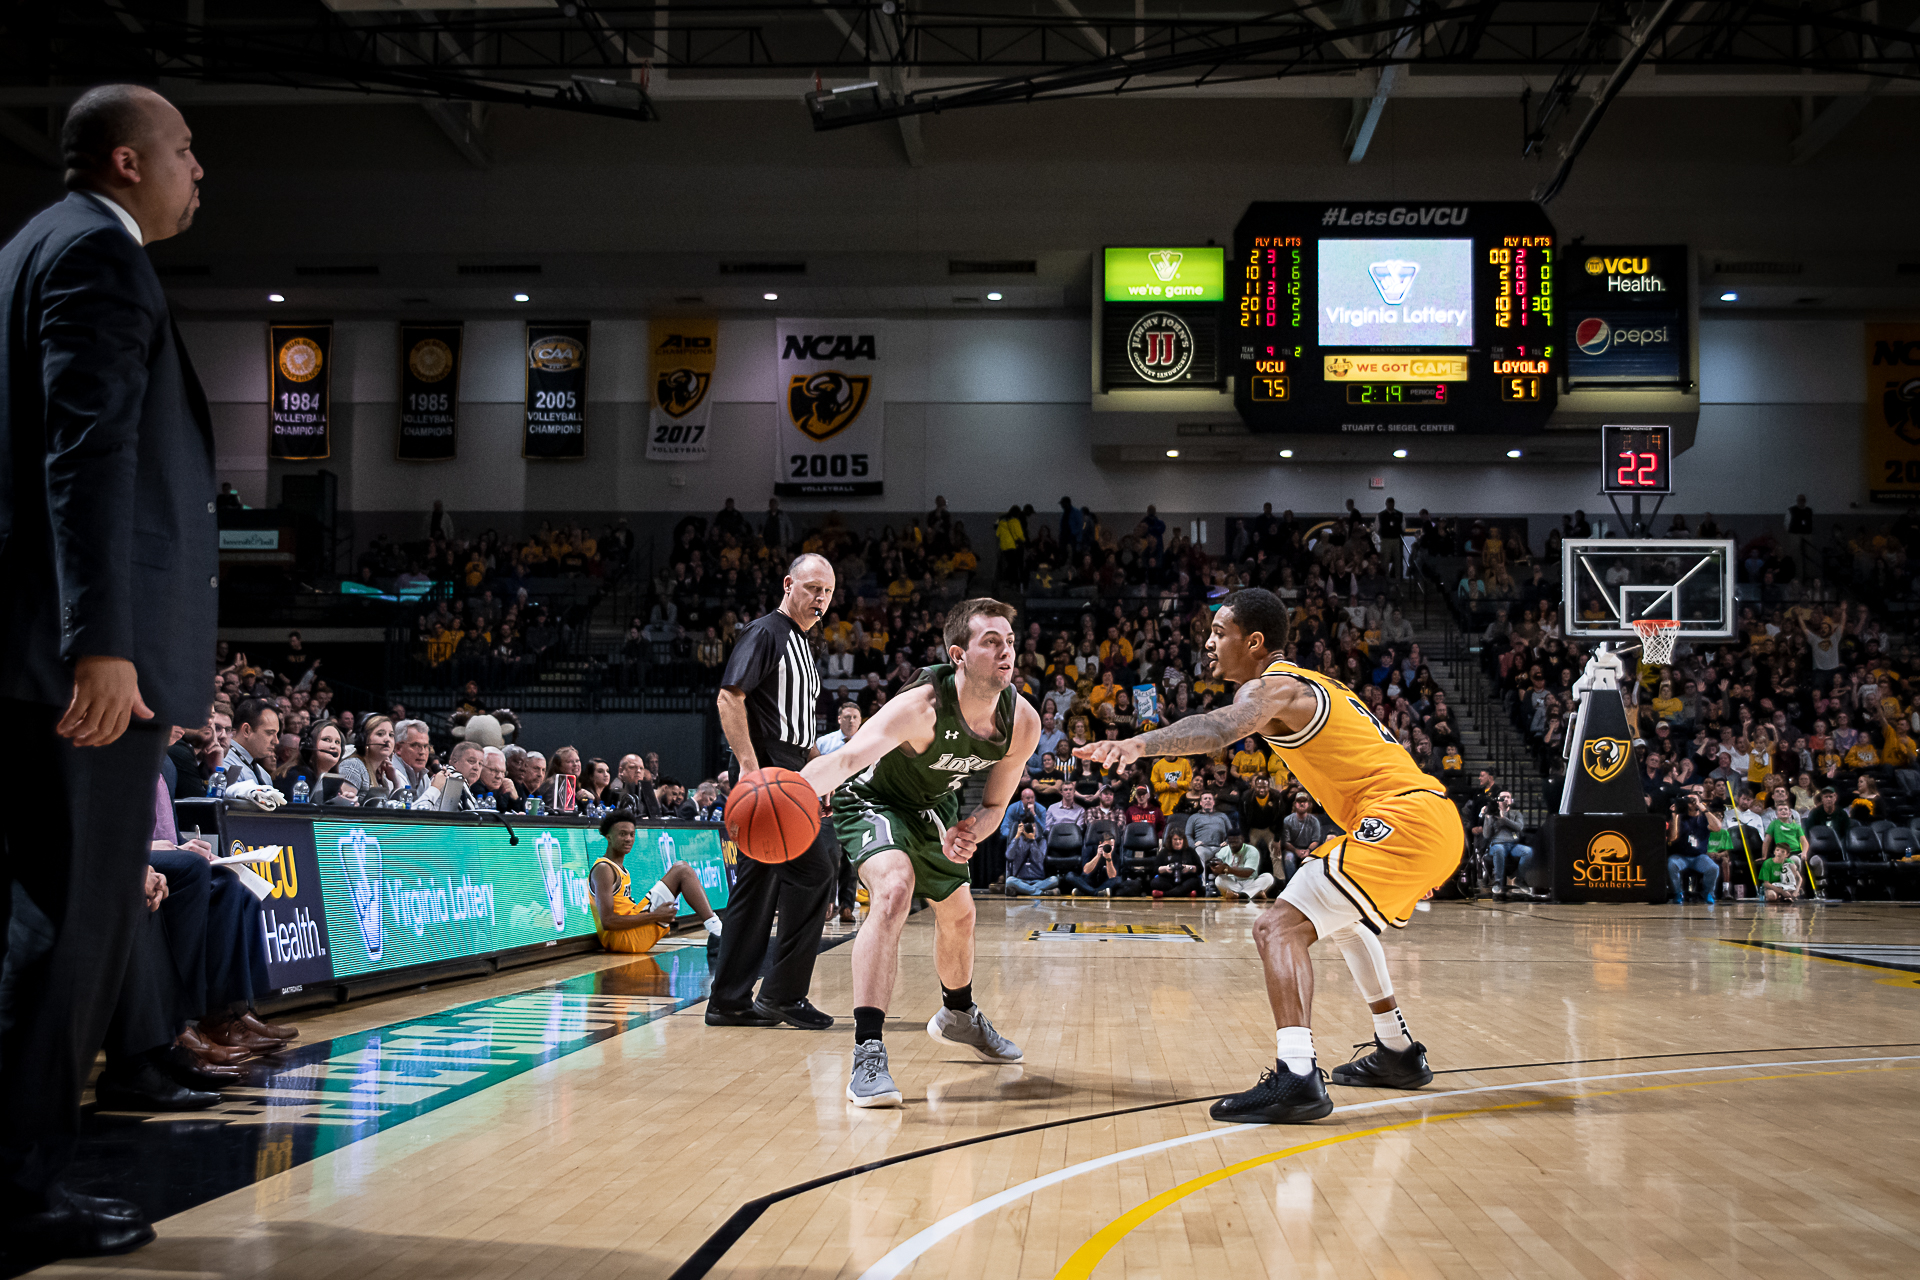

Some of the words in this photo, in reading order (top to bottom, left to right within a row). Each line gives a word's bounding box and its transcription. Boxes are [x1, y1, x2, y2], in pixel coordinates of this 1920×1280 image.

[1321, 207, 1468, 227] #LetsGoVCU
[1255, 237, 1270, 247] PLY
[1273, 237, 1284, 247] FL
[1285, 237, 1301, 247] PTS
[1503, 237, 1519, 247] PLY
[1522, 237, 1533, 247] FL
[1534, 237, 1551, 247] PTS
[1250, 249, 1259, 264] 2
[1267, 249, 1276, 264] 3
[1291, 249, 1300, 264] 5
[1489, 248, 1511, 264] 00
[1515, 248, 1526, 264] 2
[1541, 248, 1553, 264] 7
[1246, 265, 1259, 279] 10
[1271, 265, 1276, 279] 1
[1291, 265, 1300, 279] 6
[1499, 265, 1511, 280] 2
[1515, 265, 1526, 280] 0
[1541, 265, 1552, 280] 0
[1604, 258, 1650, 274] VCU
[1127, 284, 1161, 297] we're
[1164, 284, 1203, 298] game
[1246, 281, 1259, 295] 11
[1267, 281, 1276, 295] 3
[1287, 281, 1300, 295] 12
[1500, 281, 1511, 295] 3
[1515, 281, 1526, 295] 0
[1541, 281, 1552, 295] 0
[1608, 276, 1662, 292] Health
[1240, 296, 1259, 311] 20
[1266, 296, 1276, 311] 0
[1291, 296, 1300, 311] 2
[1495, 296, 1511, 311] 10
[1521, 296, 1527, 311] 1
[1532, 296, 1553, 311] 30
[1240, 312, 1259, 327] 21
[1266, 312, 1276, 327] 0
[1291, 312, 1300, 327] 2
[1325, 305, 1398, 327] Virginia
[1402, 305, 1466, 327] Lottery
[1495, 312, 1511, 327] 12
[1521, 312, 1527, 327] 1
[1542, 312, 1553, 327] 7
[1132, 317, 1159, 349] JIMMY
[1161, 317, 1189, 349] JOHN'S
[1613, 325, 1667, 347] pepsi
[538, 347, 574, 360] CAA
[781, 335, 877, 360] NCAA
[1145, 331, 1175, 366] JJ
[1266, 345, 1275, 357] 9
[1294, 345, 1303, 358] 2
[1517, 345, 1526, 357] 7
[1543, 345, 1554, 358] 2
[1255, 361, 1285, 373] VCU
[1356, 363, 1378, 373] WE
[1381, 363, 1409, 373] GOT
[1411, 361, 1463, 375] GAME
[1493, 360, 1549, 374] LOYOLA
[1262, 379, 1285, 398] 75
[1361, 385, 1402, 403] 2:19
[1409, 388, 1436, 396] PERIOD
[1435, 384, 1445, 400] 2
[1511, 379, 1538, 398] 51
[280, 392, 321, 411] 1984
[408, 393, 449, 412] 1985
[535, 391, 577, 409] 2005
[273, 412, 327, 423] VOLLEYBALL
[527, 411, 583, 422] VOLLEYBALL
[274, 424, 325, 436] CHAMPIONS
[529, 423, 582, 435] CHAMPIONS
[653, 424, 706, 444] 2017
[1341, 423, 1375, 432] STUART
[1376, 423, 1386, 432] C.
[1387, 423, 1418, 432] SIEGEL
[1420, 423, 1455, 432] CENTER
[652, 445, 707, 454] VOLLEYBALL
[790, 453, 869, 478] 2005
[1616, 451, 1659, 486] 22
[801, 485, 856, 493] VOLLEYBALL
[1572, 859, 1648, 882] SCHELL
[1588, 880, 1632, 889] brothers
[386, 876, 451, 938] Virginia
[447, 873, 497, 927] Lottery
[262, 906, 322, 965] Health
[281, 984, 304, 995] DAKTRONICS
